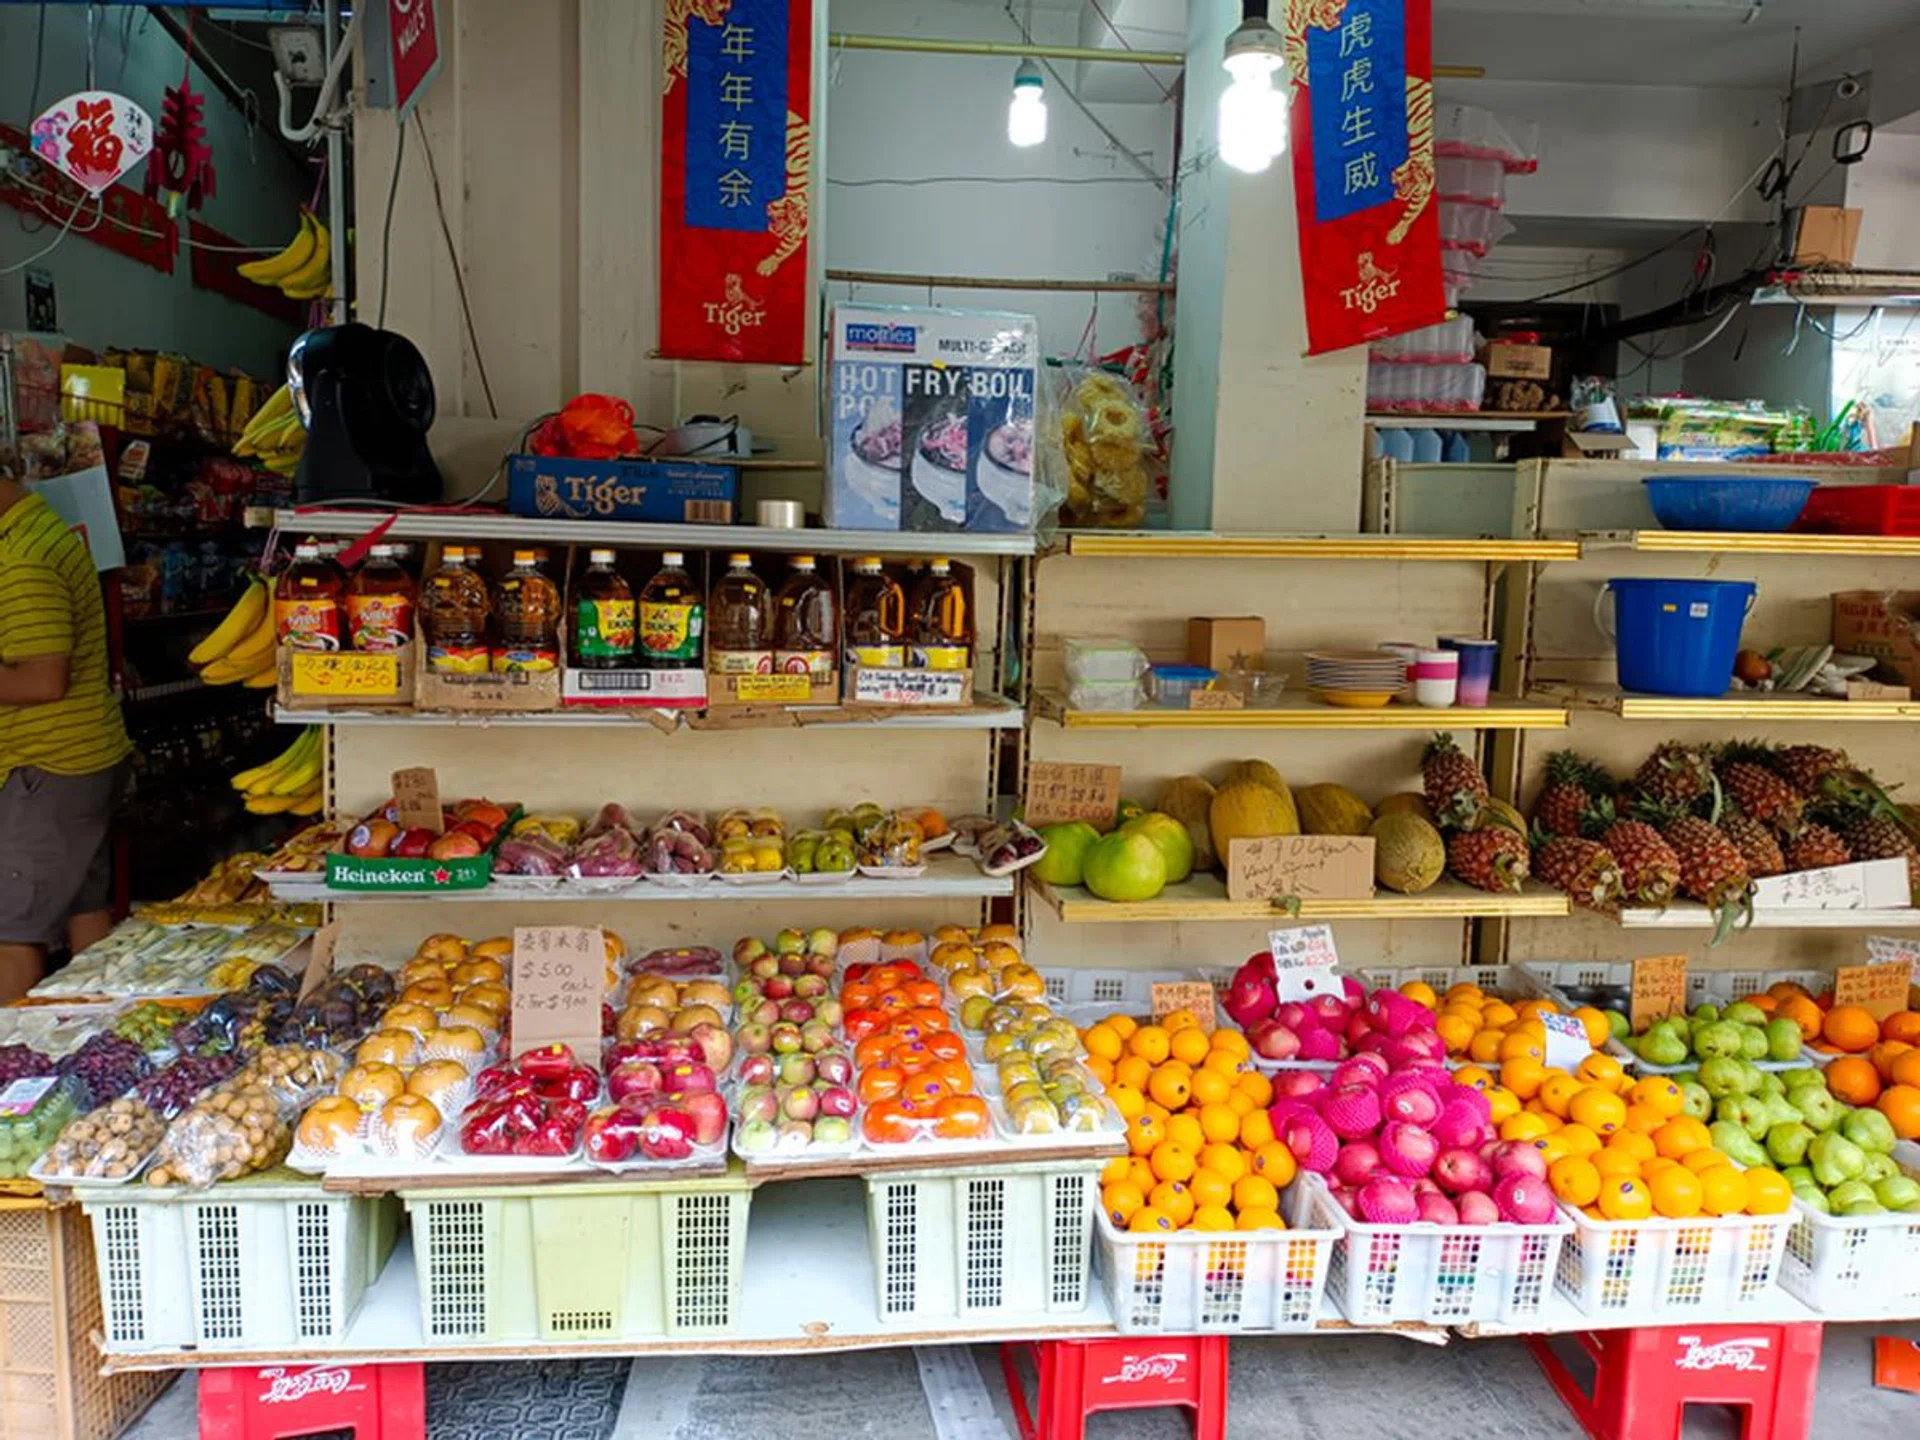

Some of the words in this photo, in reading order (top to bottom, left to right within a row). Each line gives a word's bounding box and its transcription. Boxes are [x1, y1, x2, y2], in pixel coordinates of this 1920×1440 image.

[718, 23, 756, 208] 年年有余
[1339, 12, 1379, 195] 虎虎生威
[66, 98, 124, 176] 福
[1339, 278, 1401, 314] Tiger
[703, 301, 767, 336] Tiger
[839, 365, 897, 393] HOT
[906, 368, 961, 396] FRY
[564, 475, 647, 514] Tiger
[333, 866, 425, 884] Heineken
[259, 1363, 363, 1403] Coca-Cola
